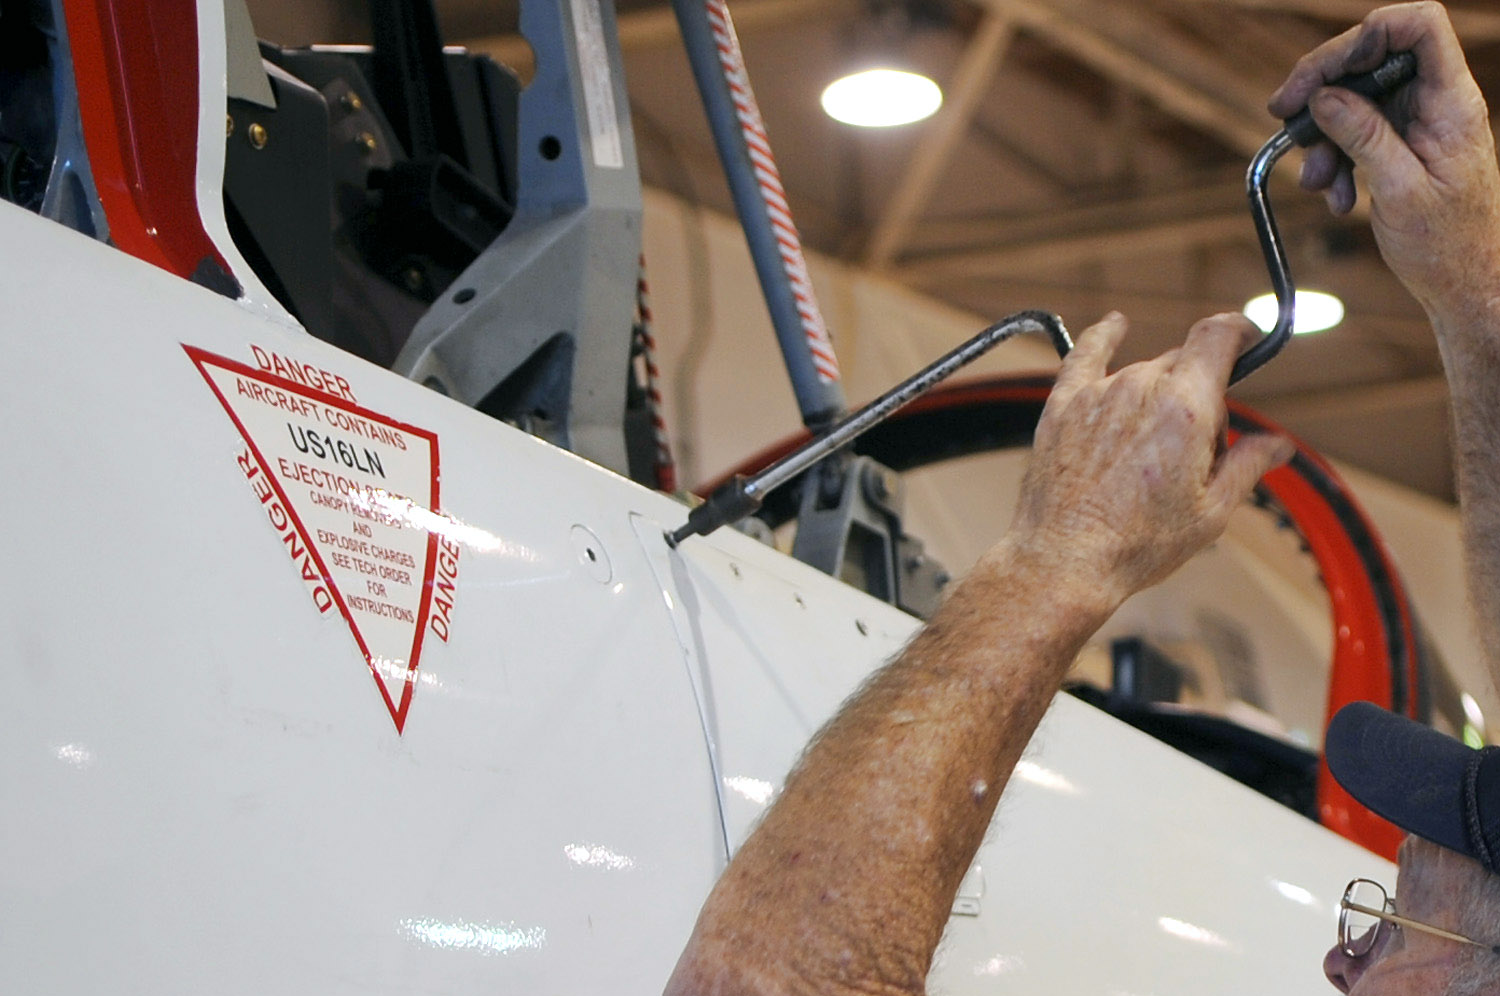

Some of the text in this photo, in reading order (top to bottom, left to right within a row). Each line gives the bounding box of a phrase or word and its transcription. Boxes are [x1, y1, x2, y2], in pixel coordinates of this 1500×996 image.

[251, 344, 357, 402] DANGER
[236, 377, 407, 451] AIRCRAFT CONTAINS
[287, 422, 386, 479] US16LN
[278, 457, 361, 497] EJECTION
[310, 490, 349, 514] CANOPY
[237, 448, 333, 613] DANGER
[317, 529, 416, 569] EXPLOSIVE CHARGES
[352, 521, 373, 538] AND
[331, 552, 413, 586] SEE TECH ORDER
[366, 580, 388, 598] FOR
[430, 514, 460, 643] DANGE
[346, 594, 415, 624] INSTRUCTIONS
